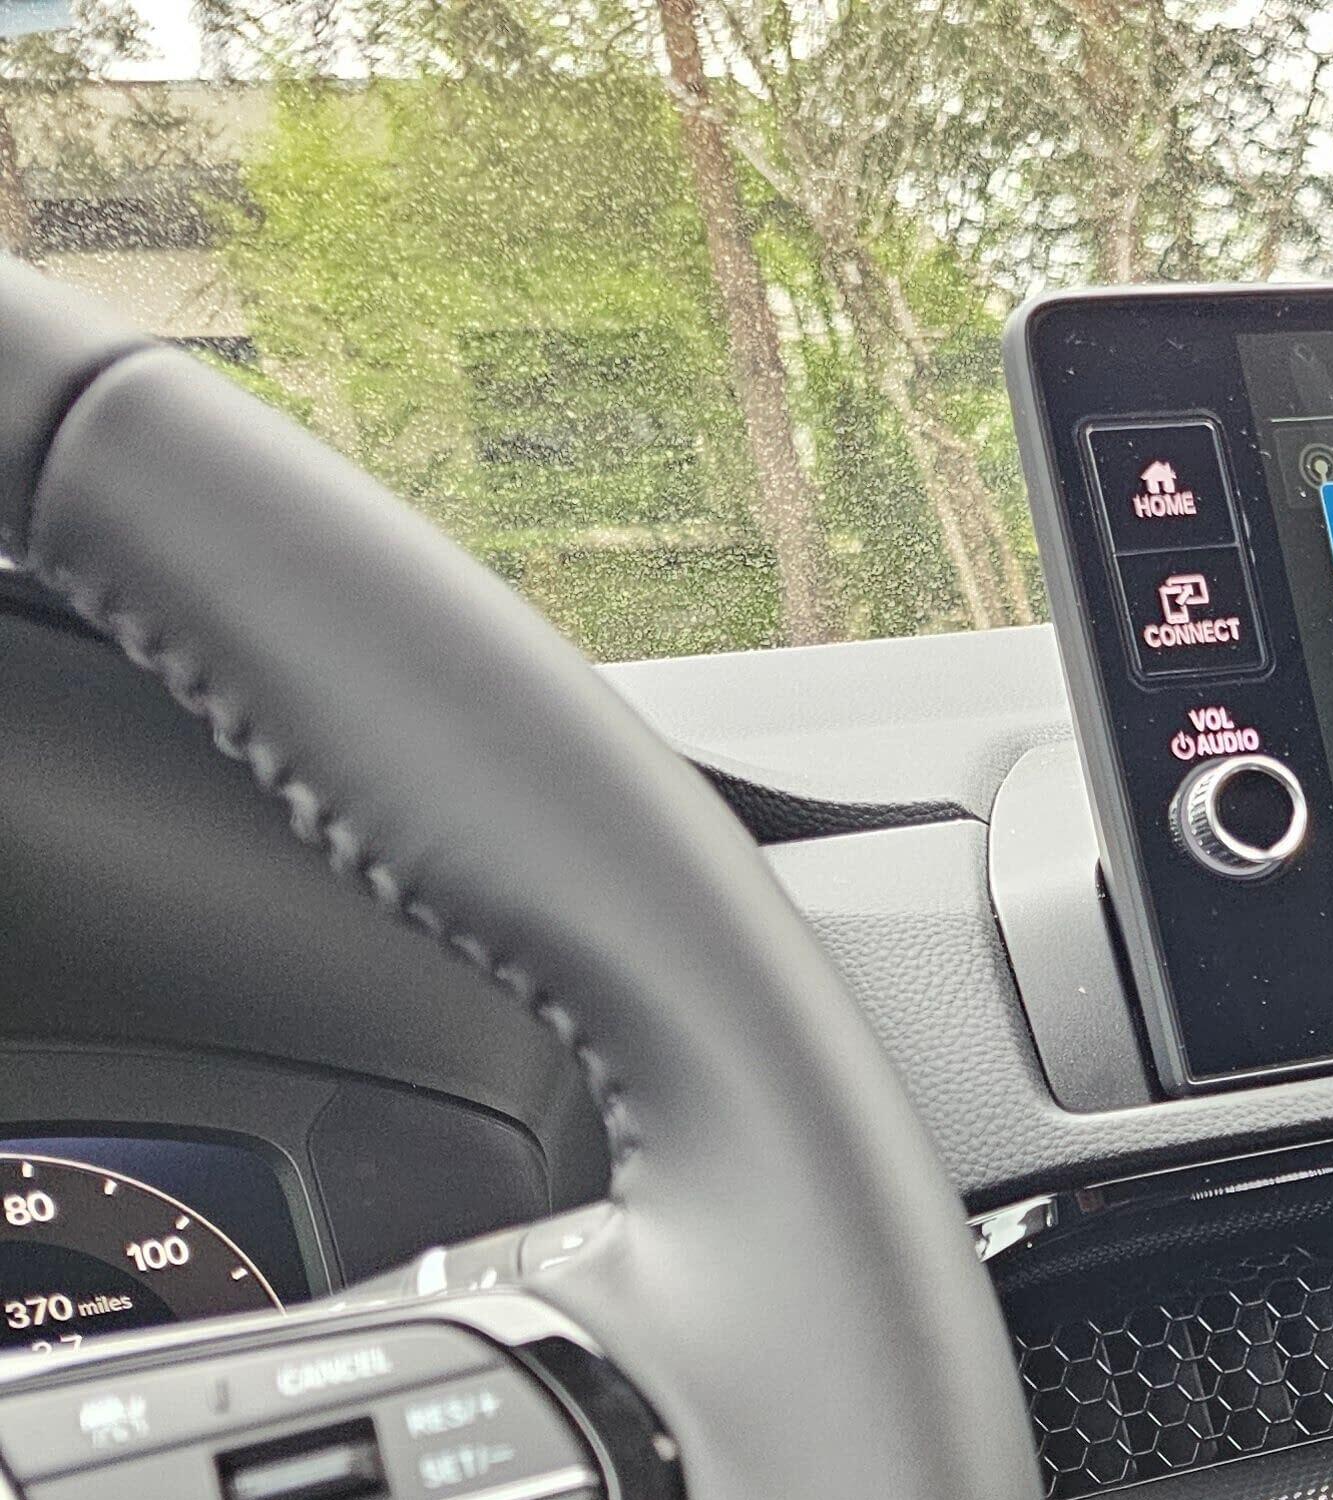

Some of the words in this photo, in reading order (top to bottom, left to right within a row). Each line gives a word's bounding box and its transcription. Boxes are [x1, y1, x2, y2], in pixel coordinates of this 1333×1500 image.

[1134, 493, 1196, 518] HOME
[1144, 618, 1240, 648] CONNECT
[1189, 708, 1234, 732] VOL
[1196, 729, 1259, 755] AUDIO
[4, 1191, 55, 1226] 80
[126, 1236, 190, 1272] 100
[5, 1294, 73, 1329] 370
[77, 1296, 134, 1317] miles
